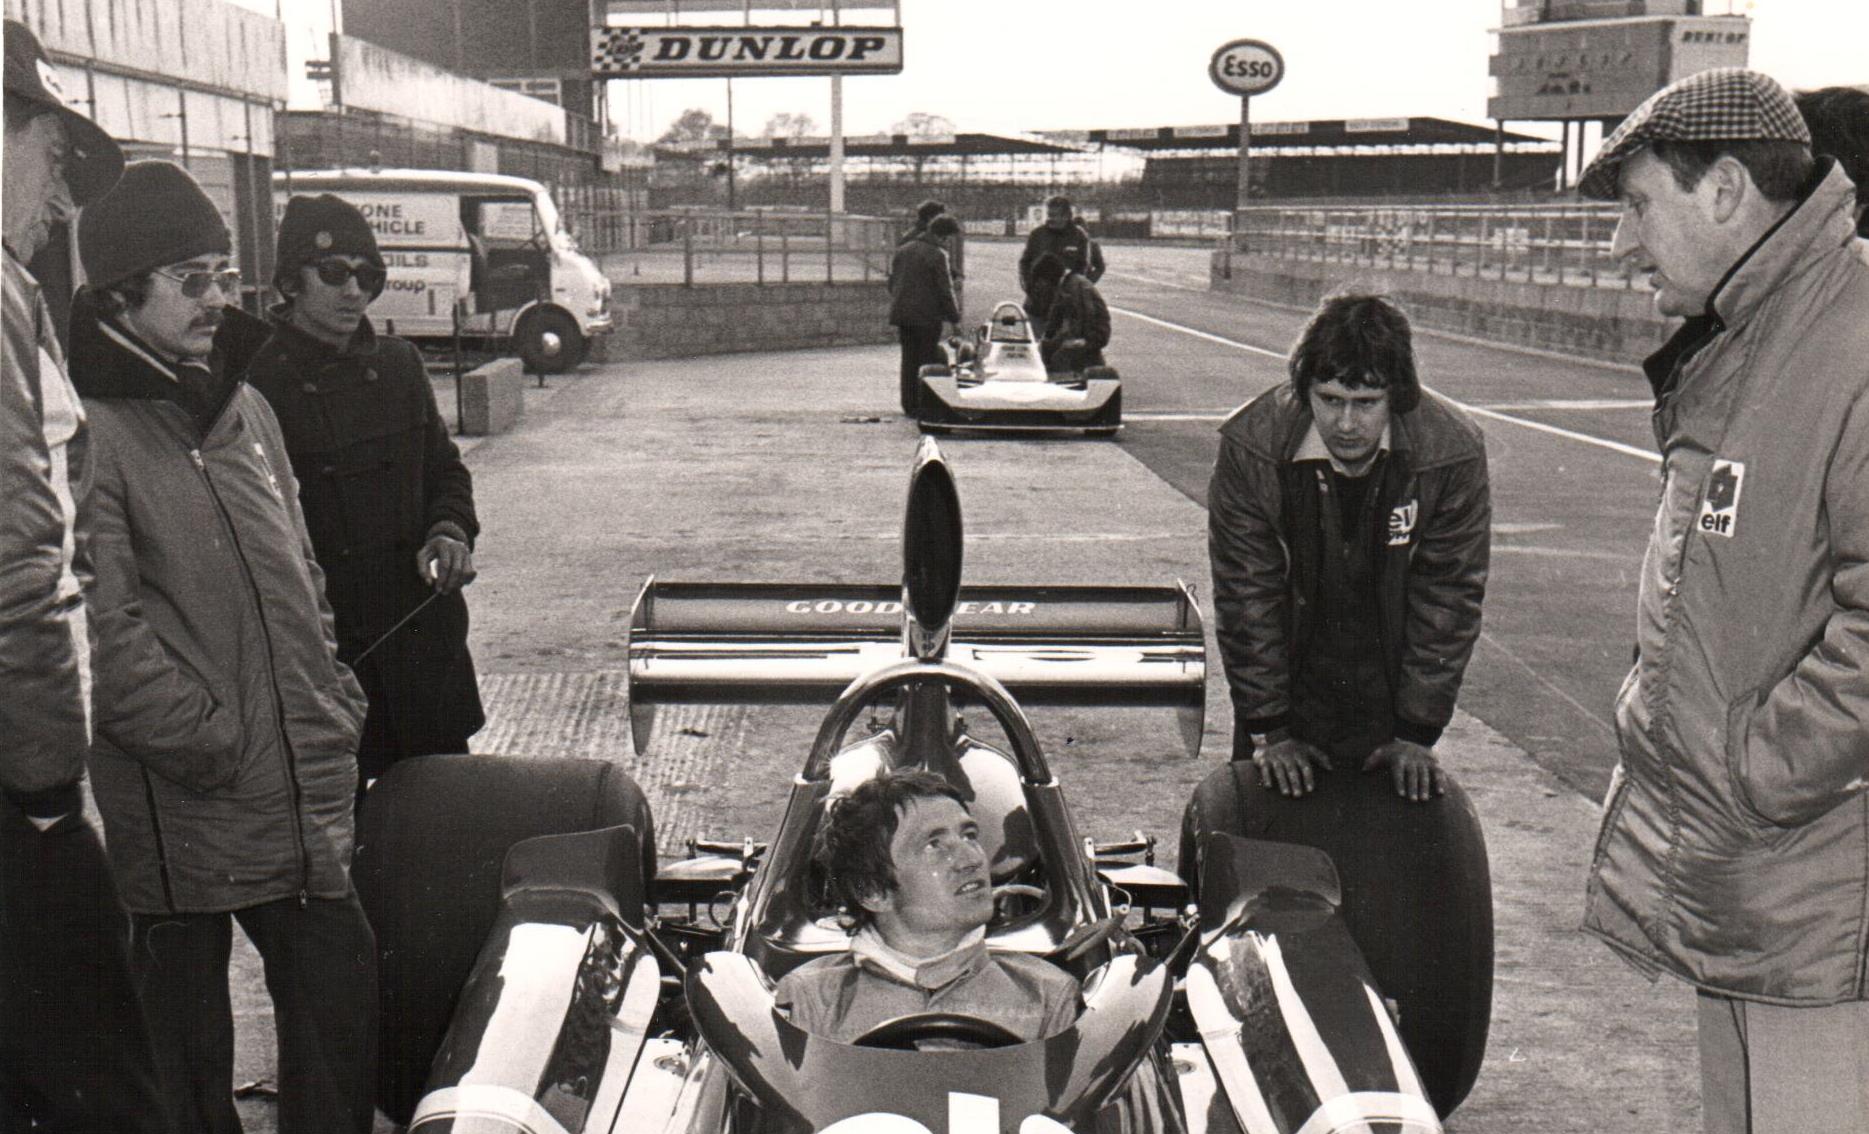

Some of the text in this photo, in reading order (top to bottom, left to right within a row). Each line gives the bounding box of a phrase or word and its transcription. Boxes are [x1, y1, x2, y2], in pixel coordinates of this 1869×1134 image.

[652, 36, 886, 60] DUNLOP
[1223, 54, 1272, 78] Esso
[357, 204, 402, 218] ONE
[370, 221, 425, 235] HICLE
[386, 279, 426, 294] roup
[1701, 513, 1731, 533] elf
